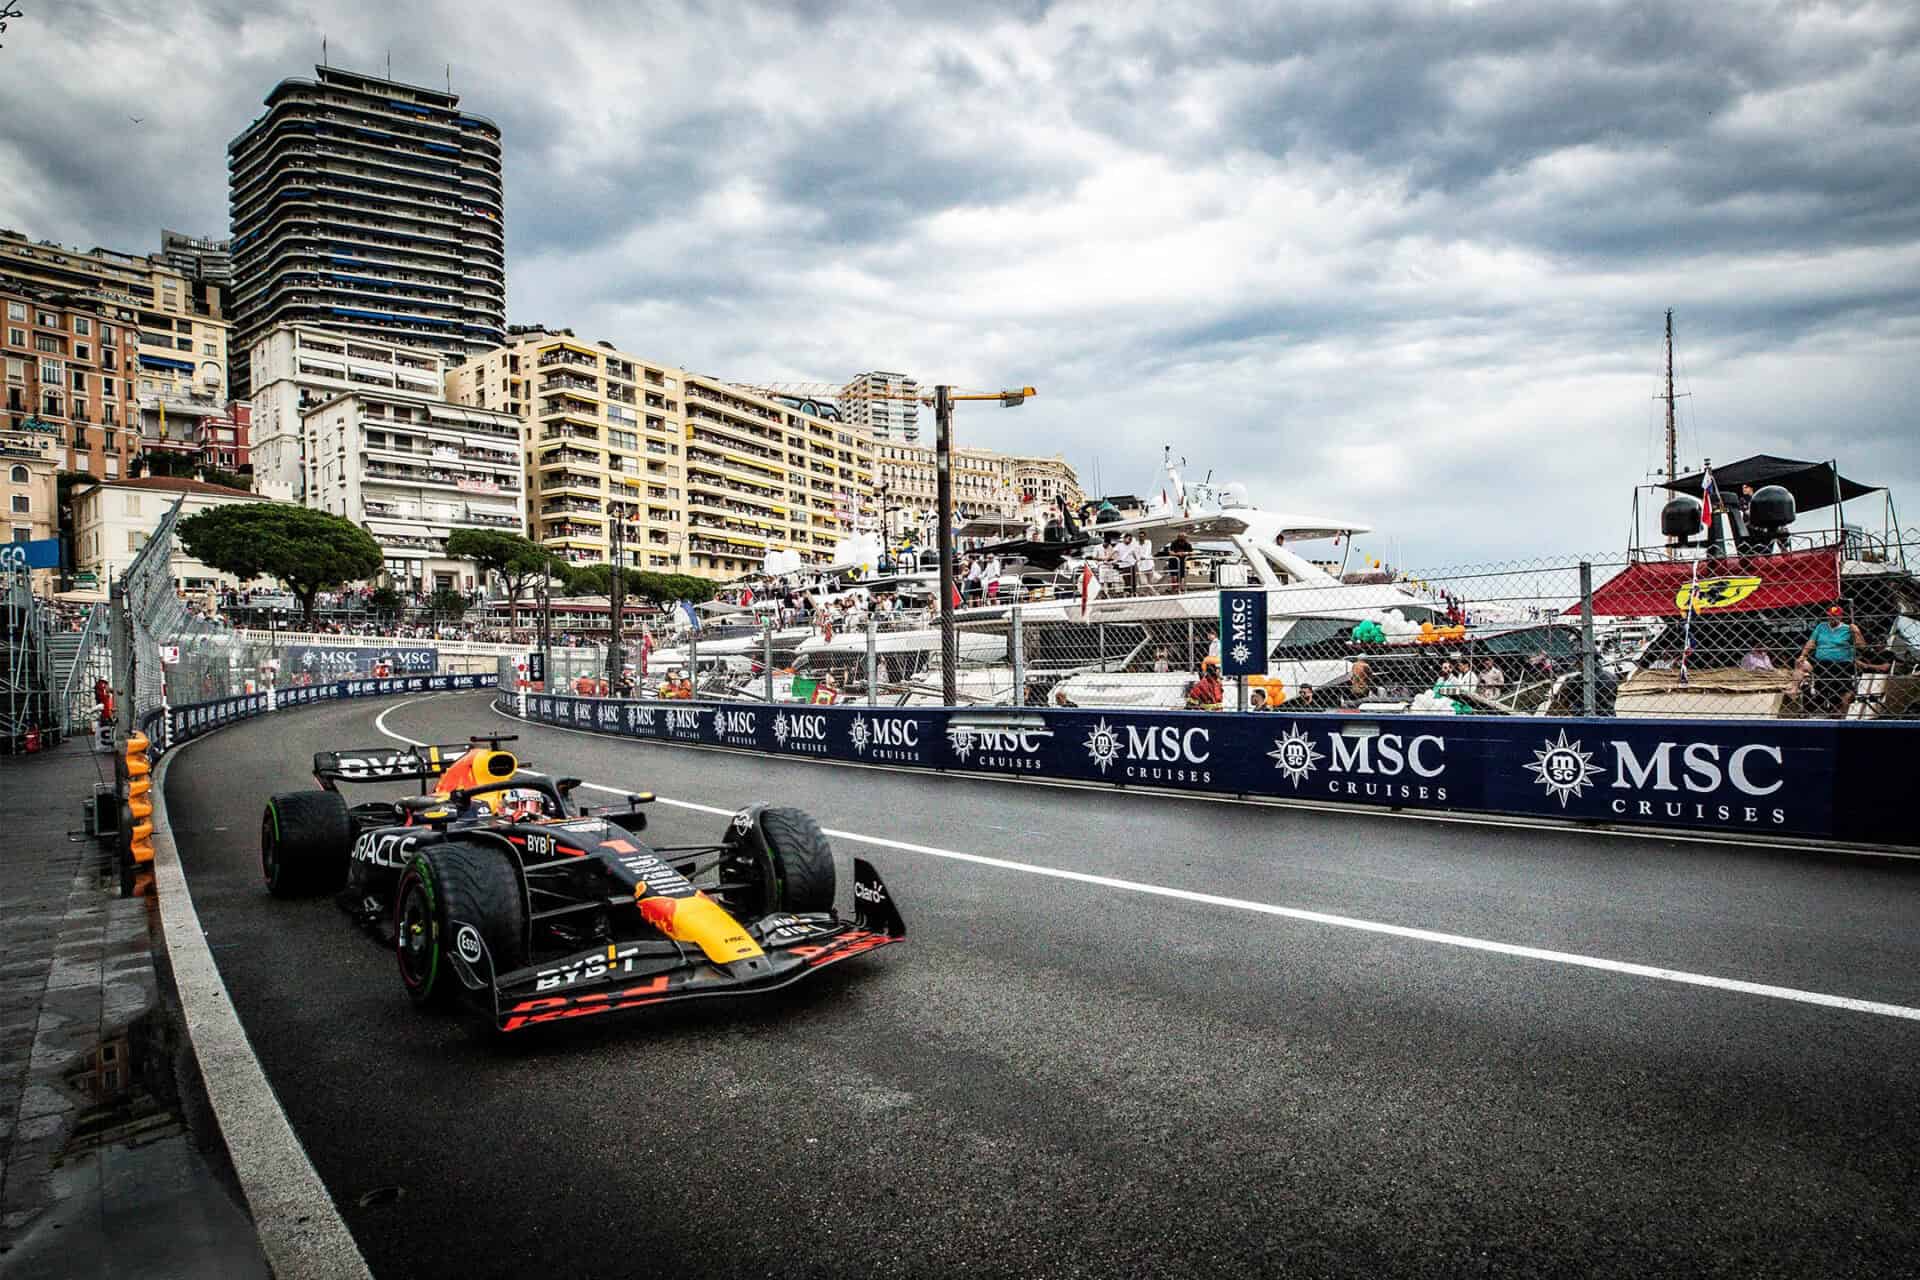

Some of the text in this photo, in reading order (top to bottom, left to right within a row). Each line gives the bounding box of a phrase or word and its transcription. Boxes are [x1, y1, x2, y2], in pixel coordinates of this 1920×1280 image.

[1232, 599, 1246, 641] MSC
[320, 651, 358, 664] MSC
[604, 704, 619, 722] MSC
[636, 706, 656, 725] MSC
[676, 708, 700, 729] MSC
[727, 711, 756, 734] MSC
[790, 714, 827, 740] MSC
[872, 718, 919, 747] MSC
[979, 731, 1040, 752] MSC
[1126, 725, 1210, 764] MSC
[873, 749, 919, 761] CRUISES
[979, 756, 1041, 769] CRUISES
[1328, 731, 1446, 777] MSC
[1126, 766, 1211, 783] CRUISES
[1610, 741, 1784, 796] MSC
[1328, 780, 1447, 800] CRUISES
[1611, 799, 1785, 824] CRUISES
[352, 833, 417, 867] RACLE
[527, 833, 556, 857] BYBIT
[536, 944, 640, 992] BYBIT
